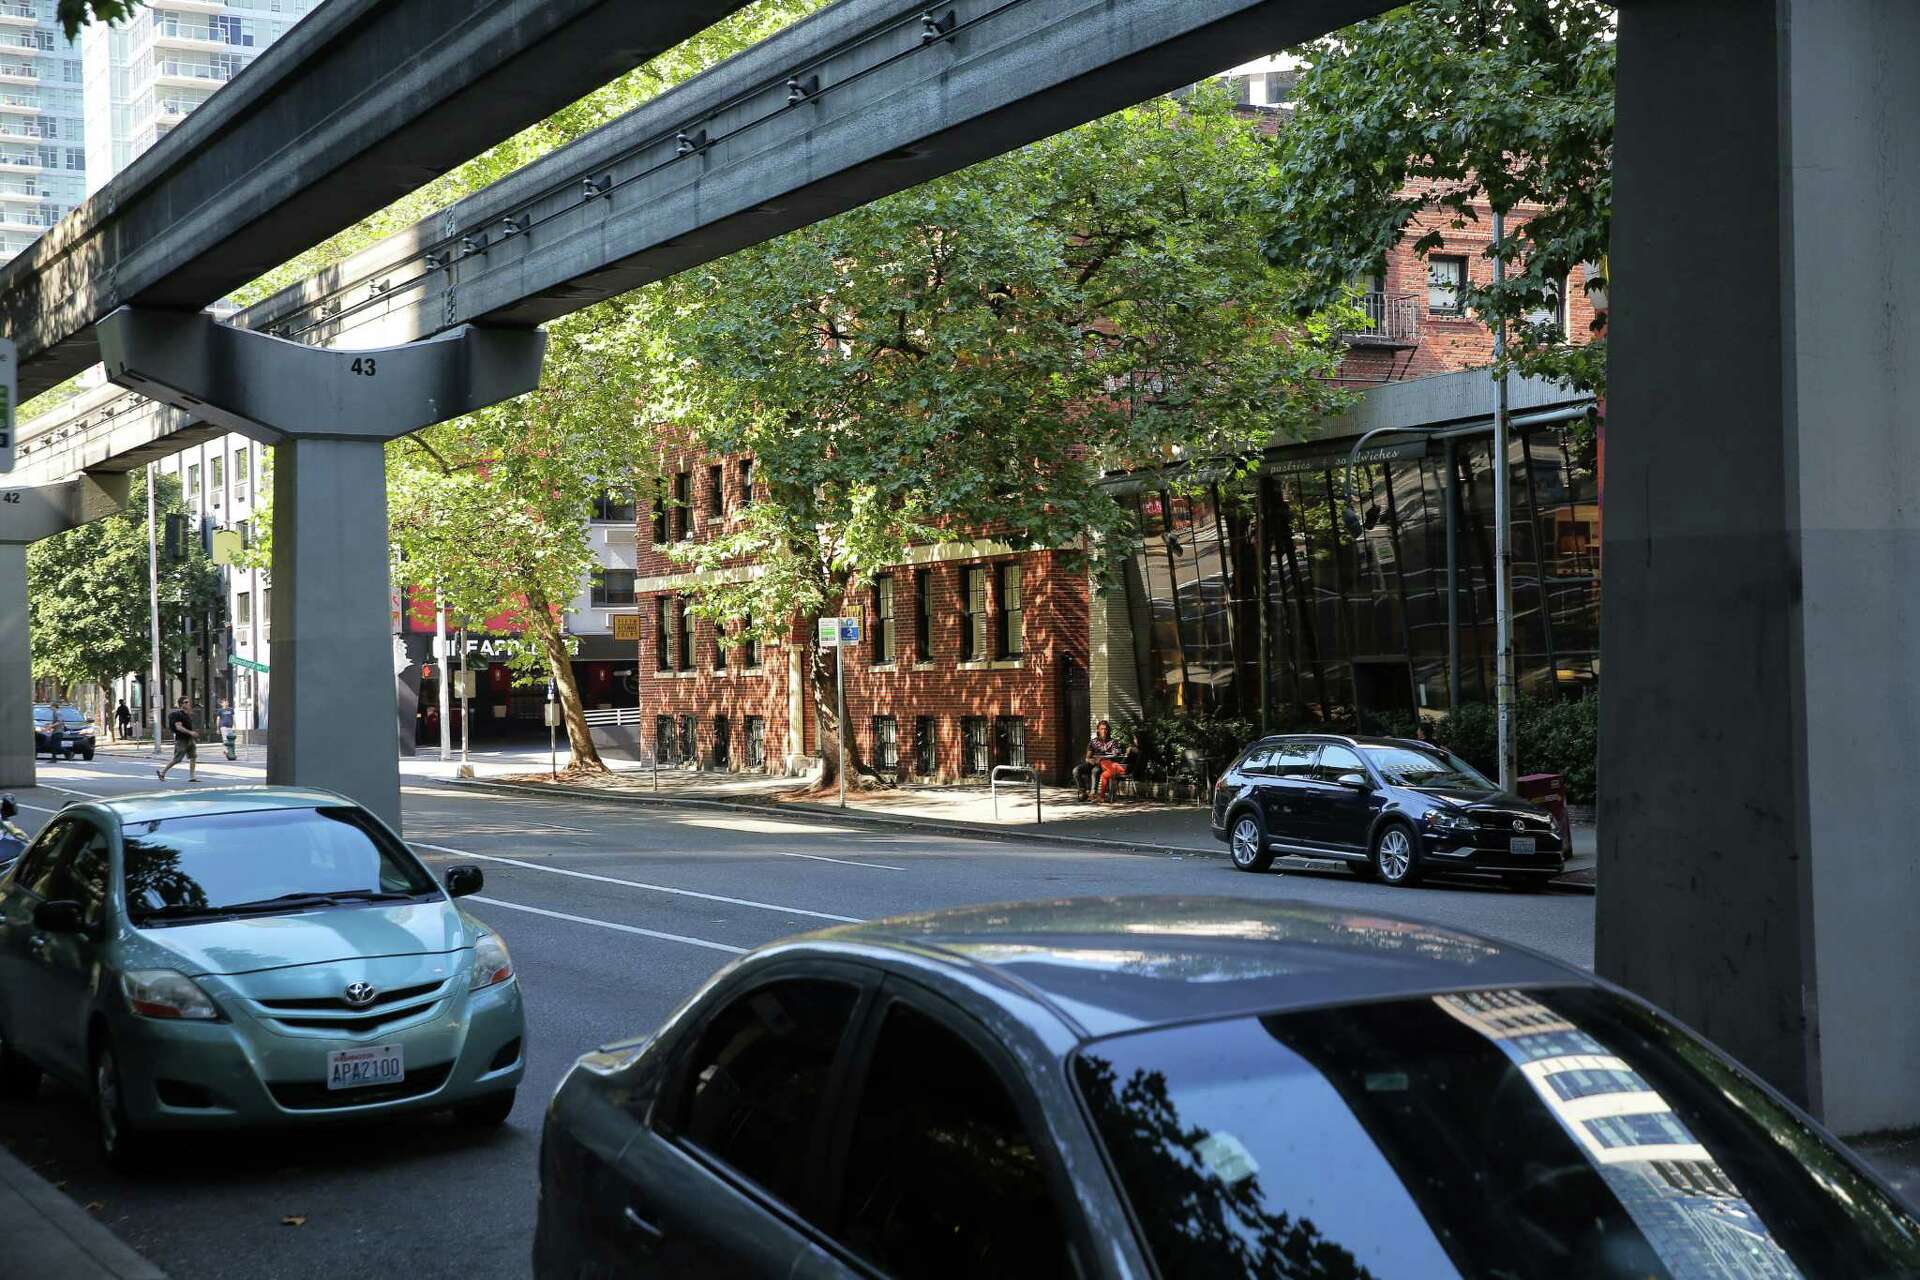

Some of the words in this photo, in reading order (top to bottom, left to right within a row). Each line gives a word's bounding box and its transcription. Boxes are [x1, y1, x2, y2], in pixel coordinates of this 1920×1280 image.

[351, 357, 376, 376] 43
[1336, 448, 1399, 465] sadwiches
[3, 492, 20, 503] 42
[332, 1056, 401, 1083] APA2100
